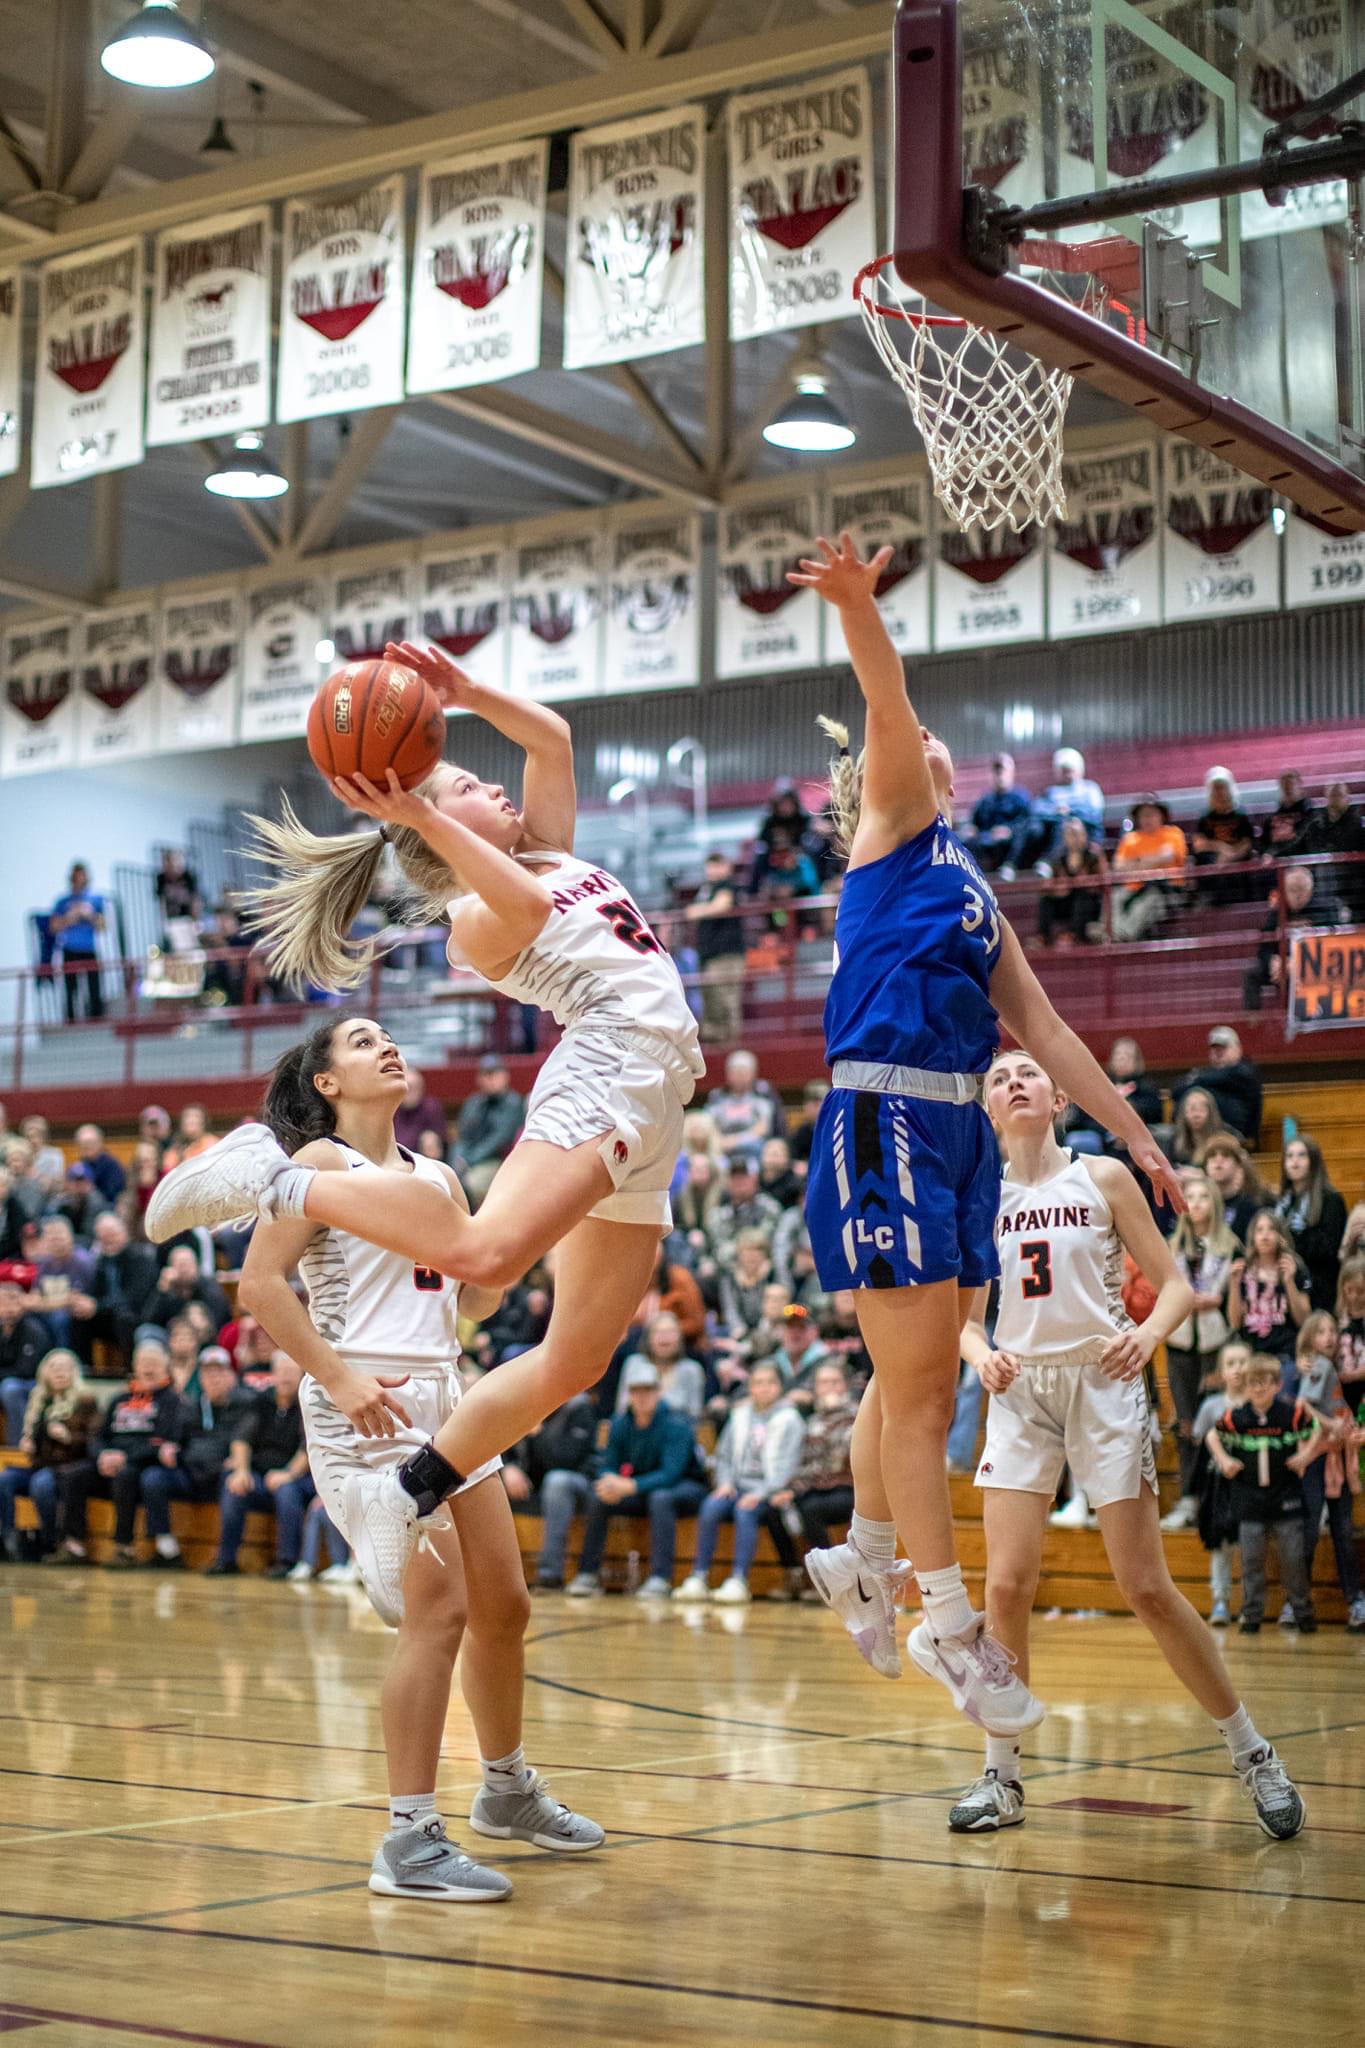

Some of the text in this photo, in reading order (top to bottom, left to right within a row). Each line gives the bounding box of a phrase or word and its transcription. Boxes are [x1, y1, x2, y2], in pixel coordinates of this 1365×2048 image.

[738, 84, 863, 163] TENNIS
[582, 122, 696, 194] TENNIS
[772, 136, 825, 161] GIRLS
[1309, 560, 1365, 589] 199
[336, 699, 351, 734] PRO
[999, 1206, 1090, 1237] APAVINE
[1019, 1240, 1053, 1300] 3
